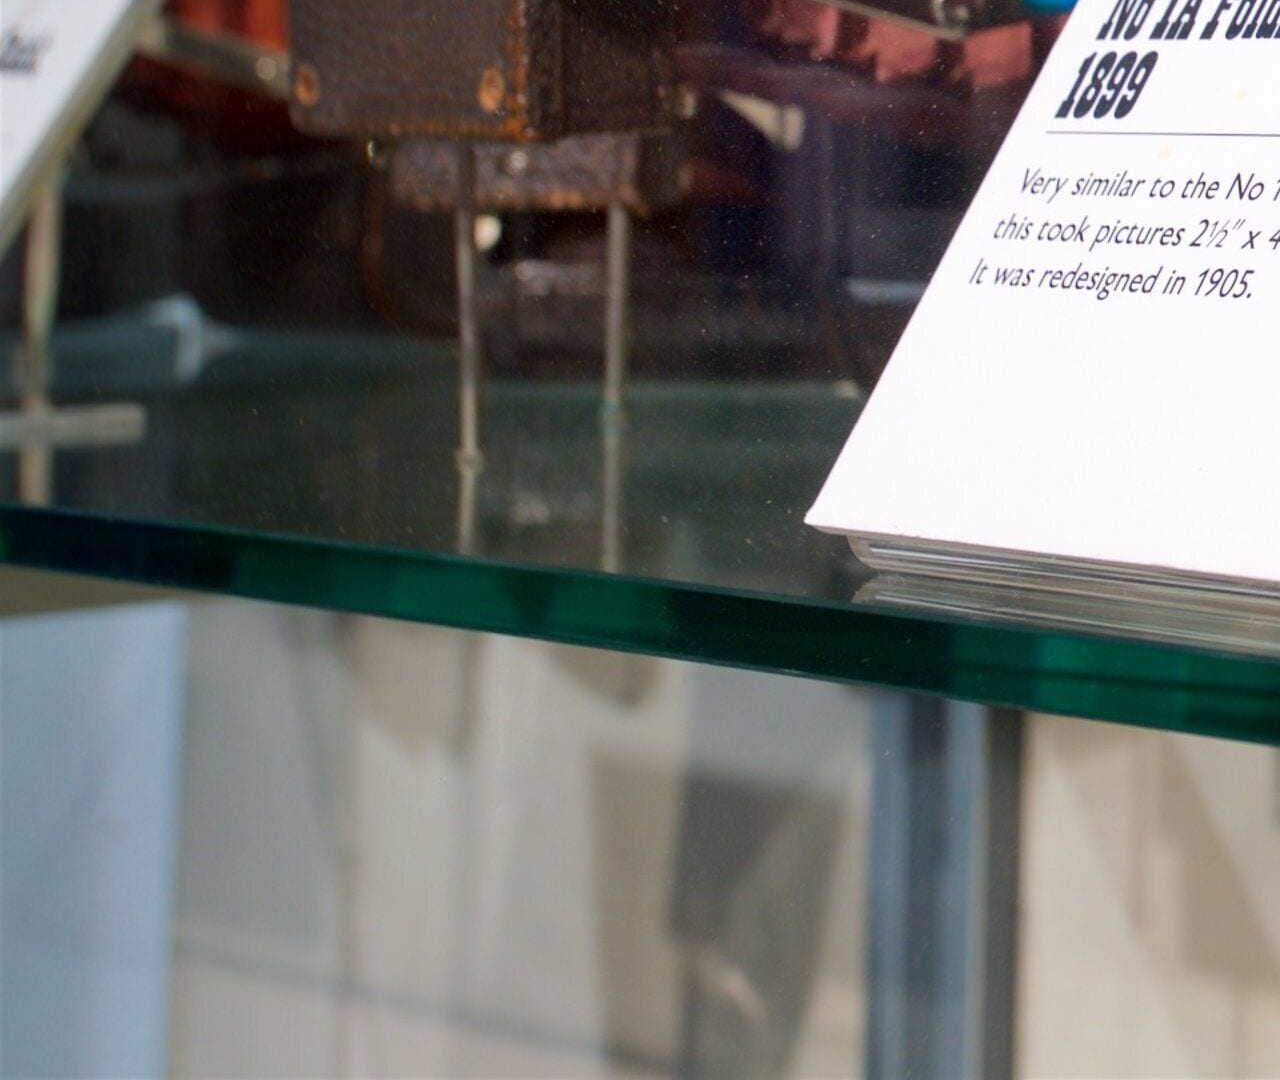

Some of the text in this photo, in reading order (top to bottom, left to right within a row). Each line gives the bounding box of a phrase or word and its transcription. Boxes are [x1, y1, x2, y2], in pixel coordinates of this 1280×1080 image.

[1054, 50, 1158, 119] 1899
[1021, 168, 1068, 204] Very
[1071, 171, 1146, 198] similar
[1149, 176, 1175, 198] to
[1181, 172, 1220, 199] the
[1225, 173, 1265, 200] No
[993, 213, 1033, 240] this
[1037, 216, 1090, 242] took
[1089, 219, 1186, 252] pictures
[1241, 230, 1262, 250] x
[969, 258, 1255, 301] It was redesigned in 1905.
